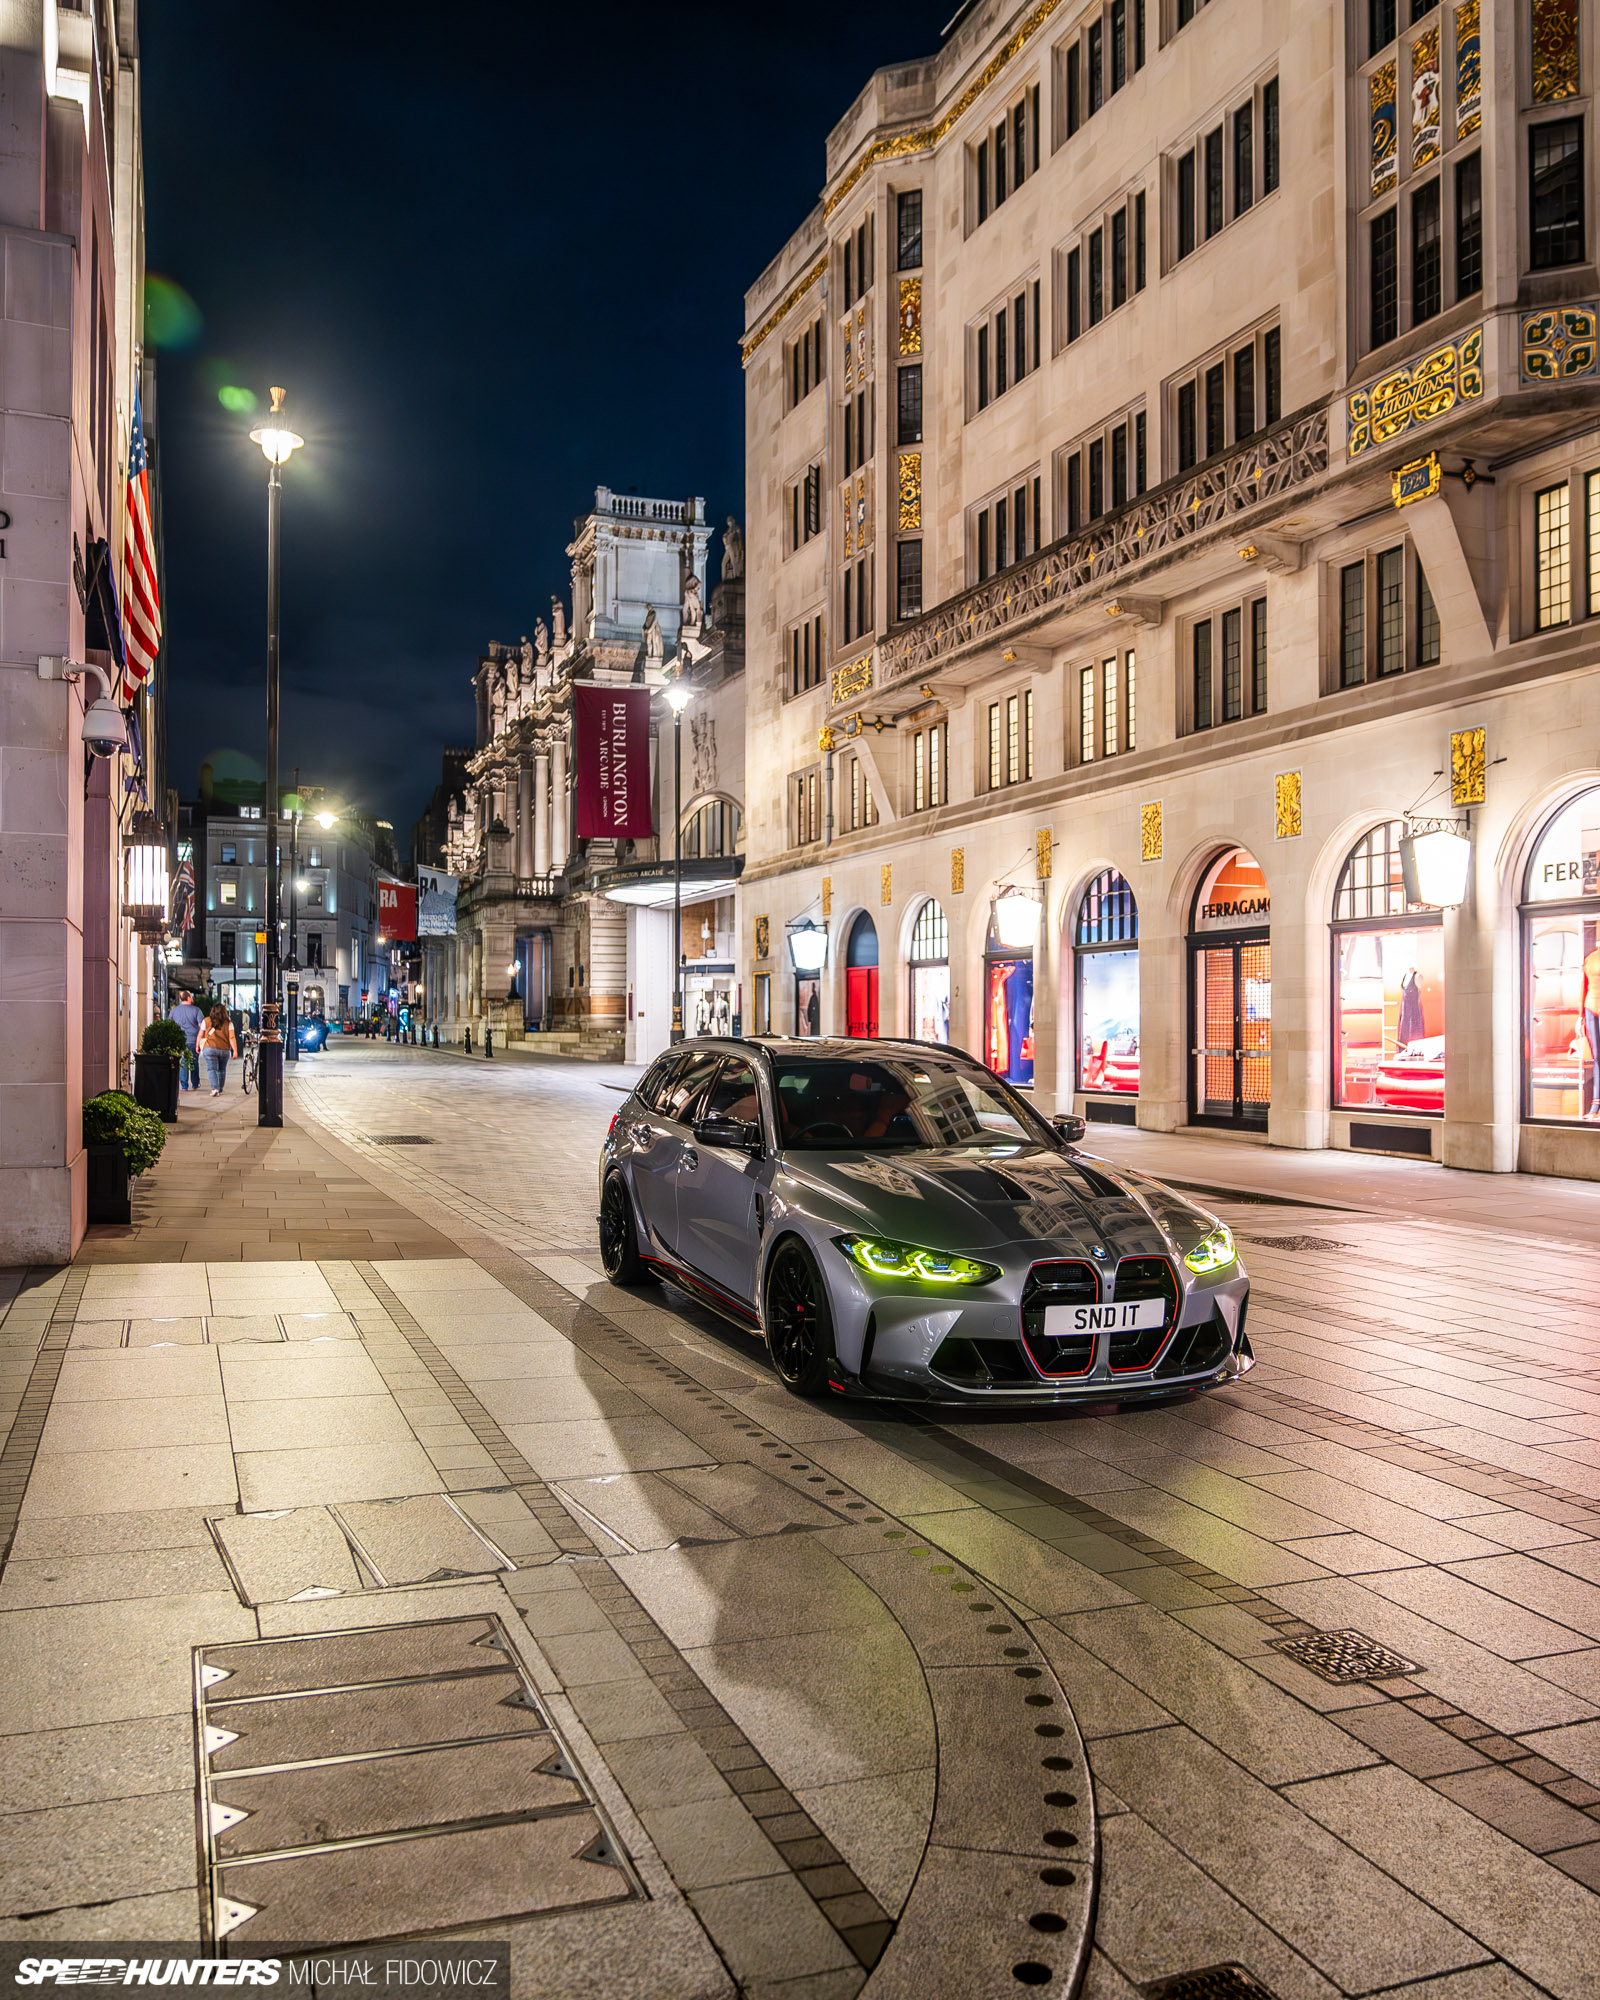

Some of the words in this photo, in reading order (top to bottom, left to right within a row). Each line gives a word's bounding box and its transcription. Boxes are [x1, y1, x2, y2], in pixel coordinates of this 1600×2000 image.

[599, 738, 609, 789] ARCADE
[612, 703, 628, 826] BURLINGTON
[640, 868, 664, 876] ARCADE
[379, 889, 398, 908] RA
[419, 876, 438, 898] RA
[1074, 1306, 1116, 1330] SND
